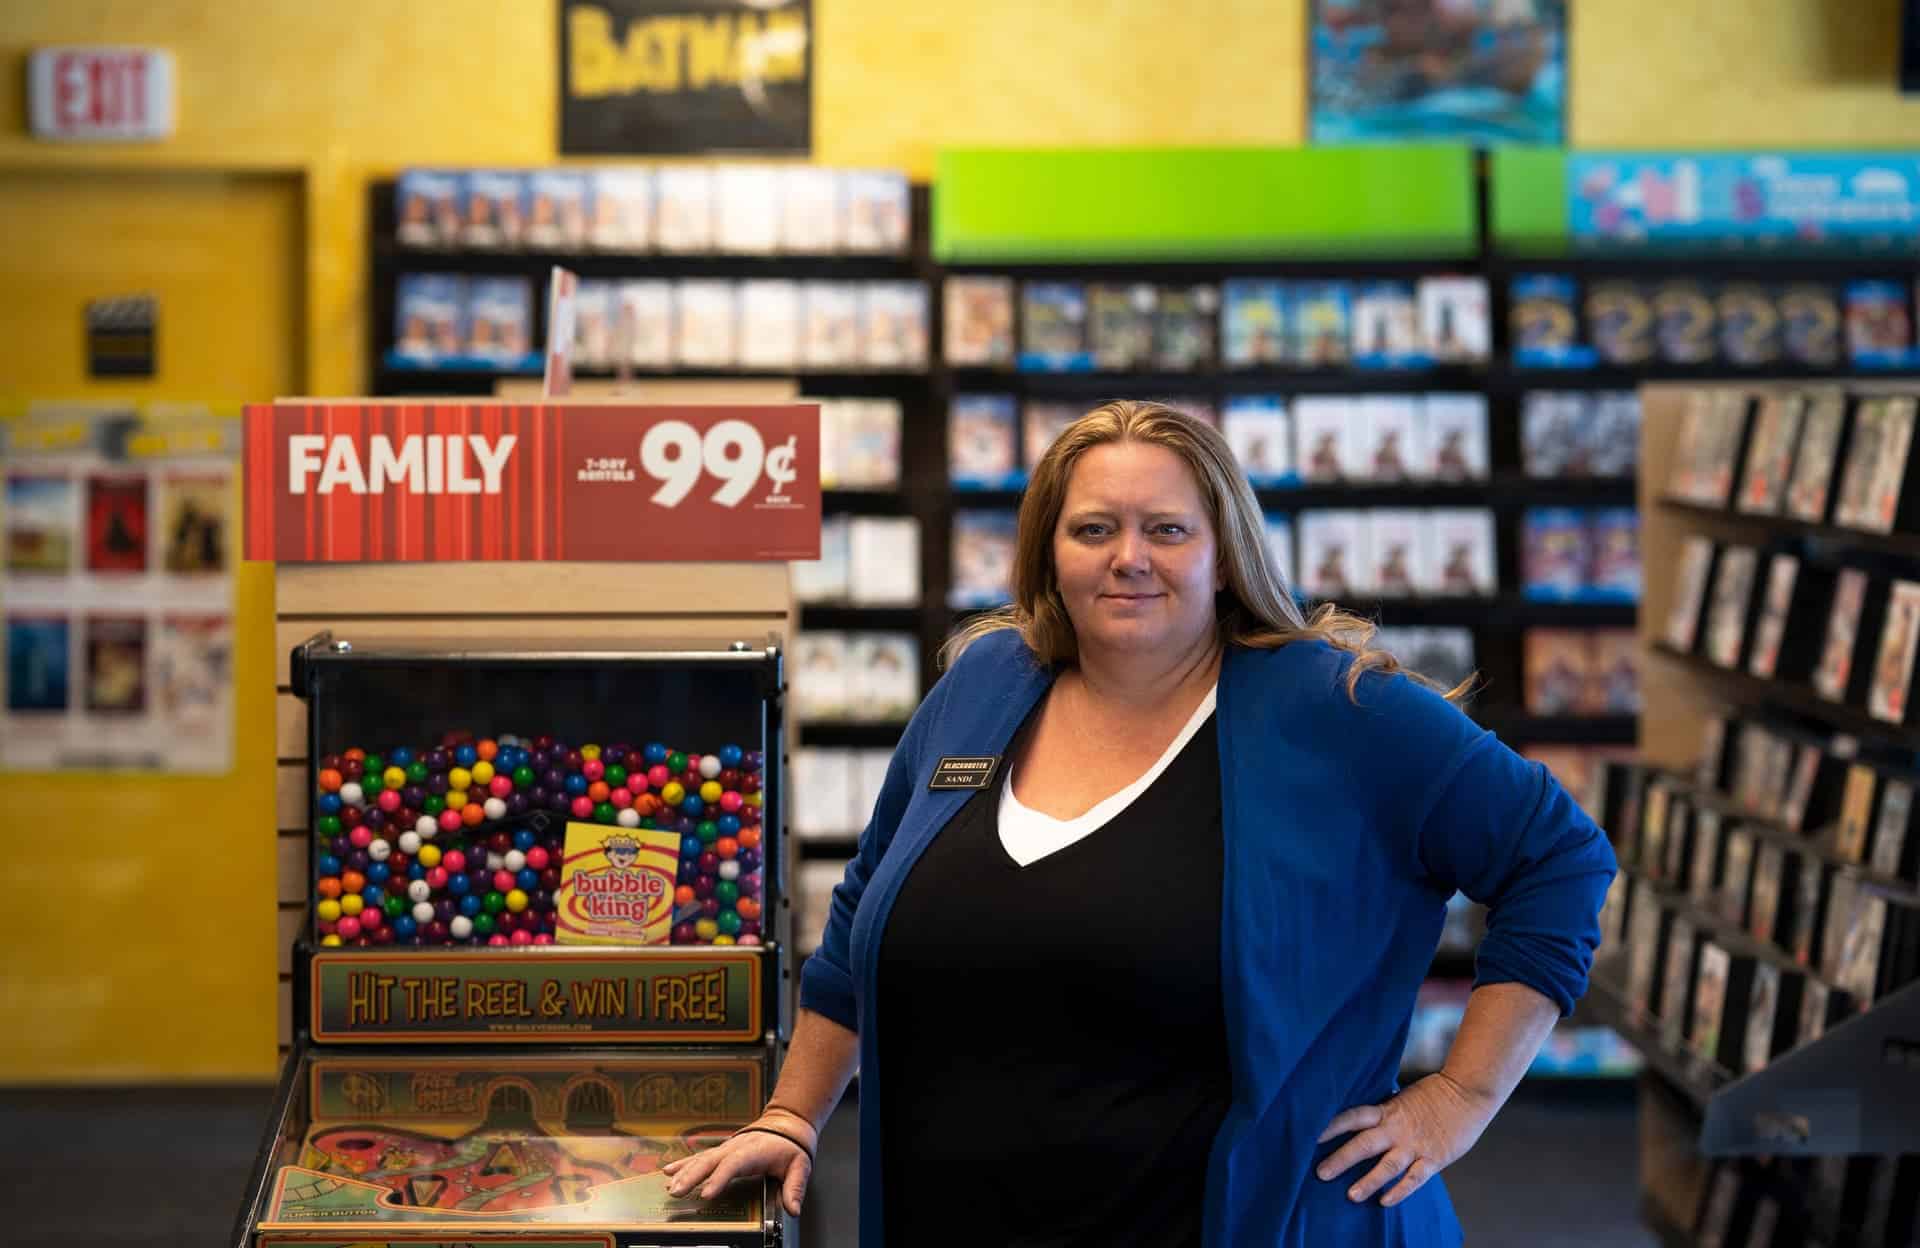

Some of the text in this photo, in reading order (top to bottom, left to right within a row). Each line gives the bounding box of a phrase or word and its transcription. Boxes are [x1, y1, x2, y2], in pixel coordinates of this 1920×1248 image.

[56, 53, 146, 130] EXIT
[288, 433, 519, 495] FAMILY
[573, 870, 664, 896] bubble
[590, 894, 648, 924] king
[349, 972, 396, 1025] HIT
[402, 977, 460, 1021] THE
[466, 981, 533, 1017] REEL
[540, 978, 568, 1017] &
[571, 977, 628, 1016] WIN
[652, 967, 728, 1023] FREE!
